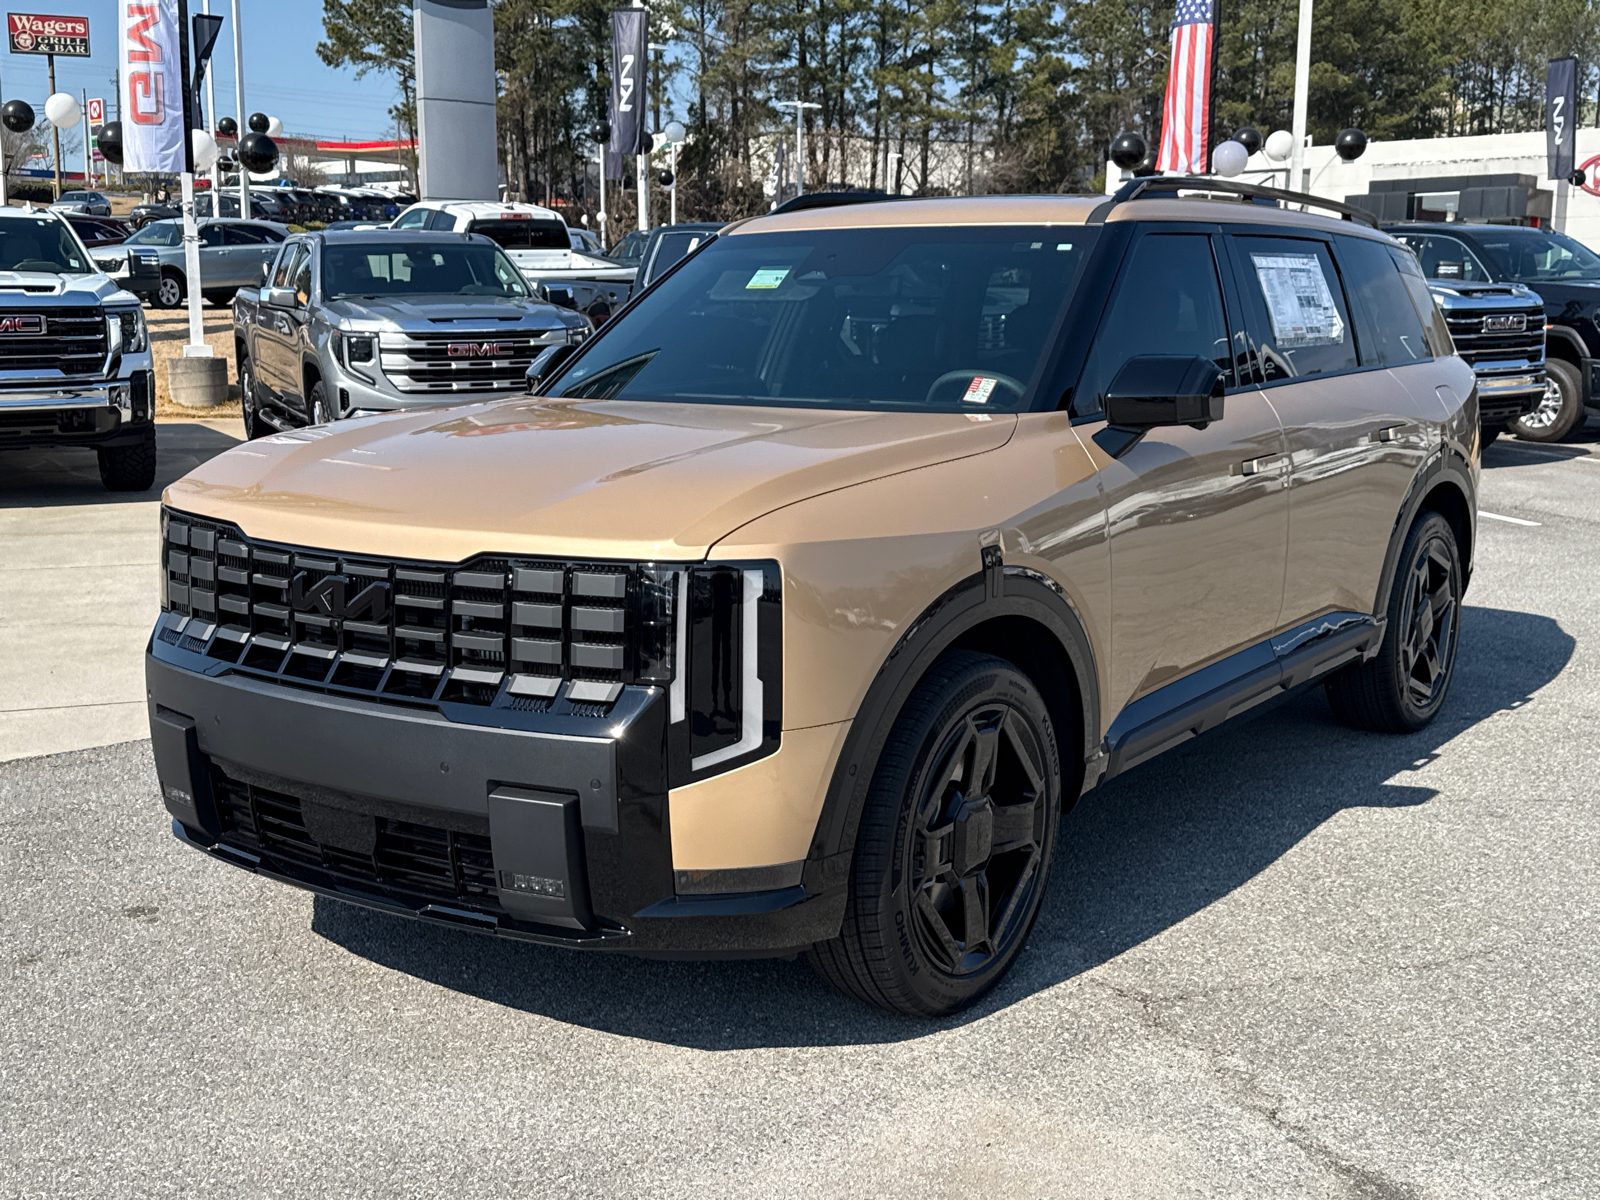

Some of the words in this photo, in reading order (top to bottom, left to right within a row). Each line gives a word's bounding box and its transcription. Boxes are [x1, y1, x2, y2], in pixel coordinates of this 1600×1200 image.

[12, 15, 86, 35] Wagers
[37, 36, 86, 46] GRILL
[37, 43, 50, 51] &
[54, 44, 86, 53] BAR
[1487, 316, 1525, 330] GMC
[447, 342, 514, 357] GMC
[292, 570, 392, 624] KIA
[1042, 714, 1059, 776] KUMHO
[895, 909, 920, 977] KUMHO
